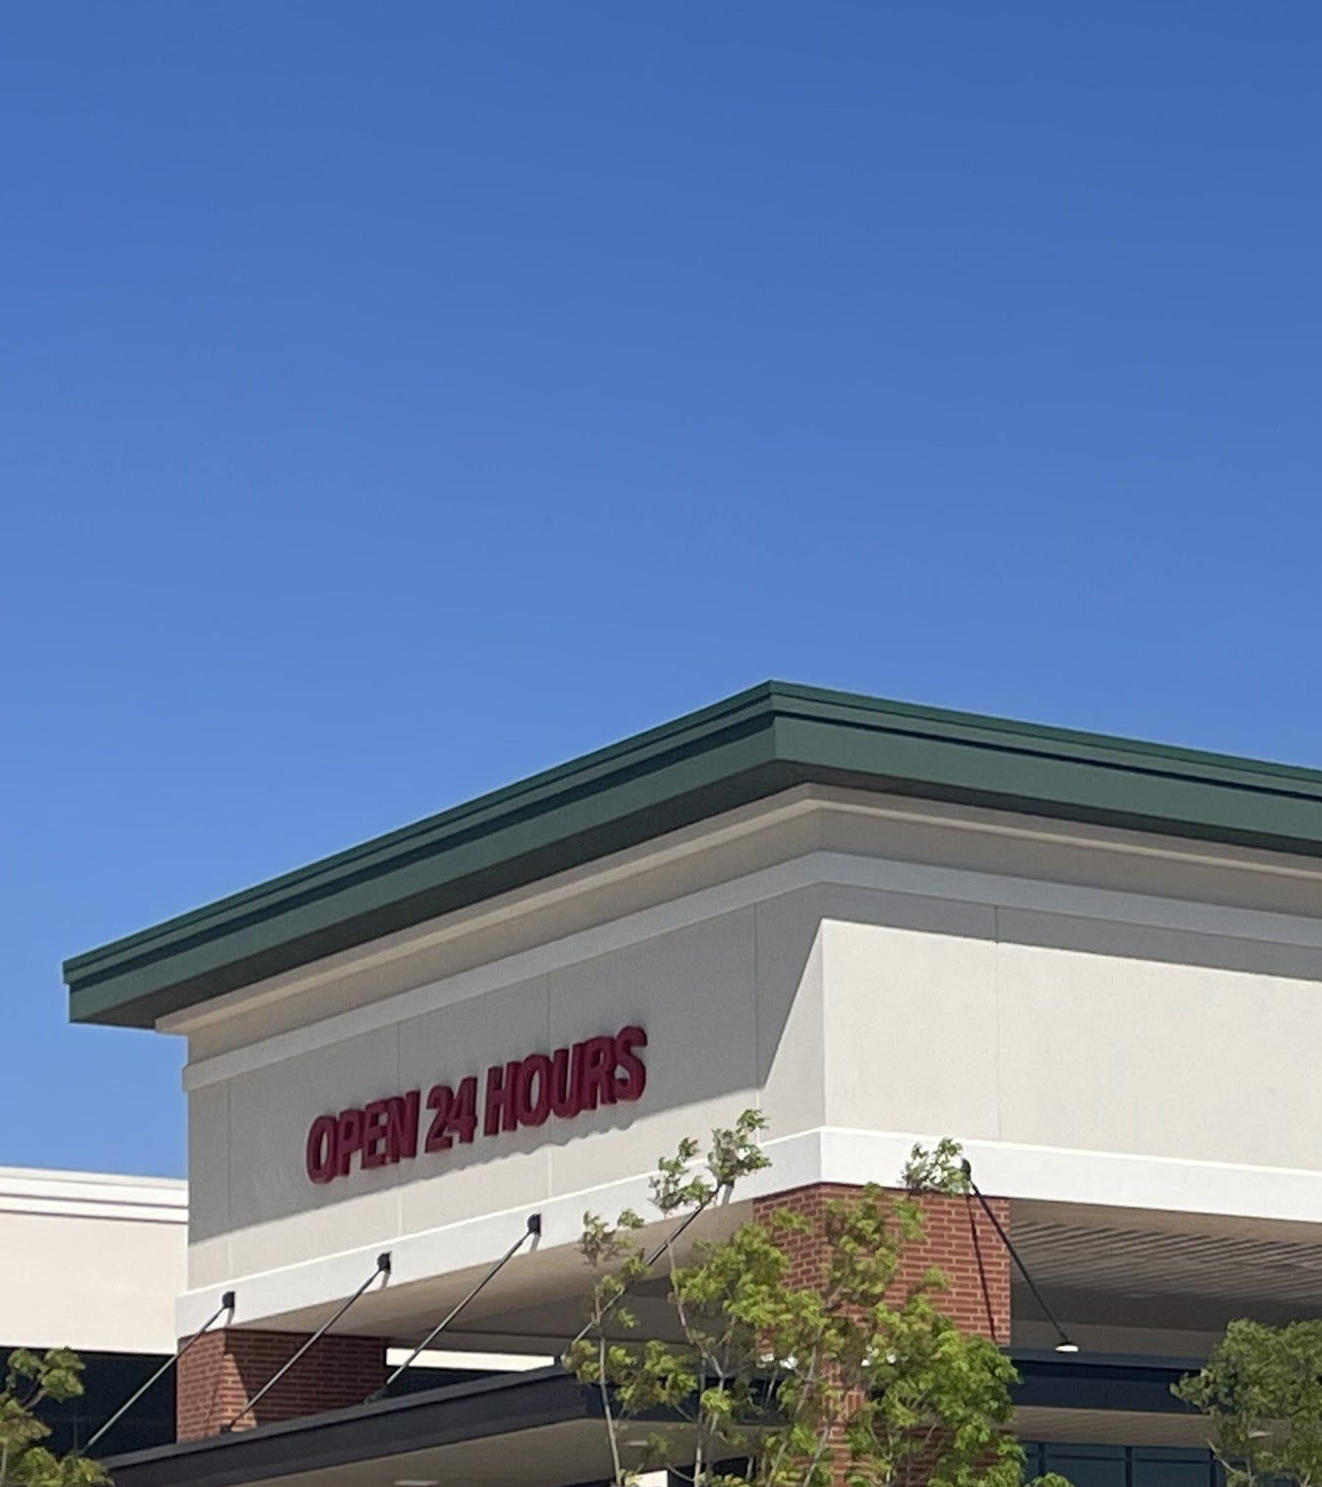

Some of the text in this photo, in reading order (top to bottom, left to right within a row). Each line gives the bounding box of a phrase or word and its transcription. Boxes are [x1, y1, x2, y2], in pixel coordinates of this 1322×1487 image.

[306, 1025, 648, 1183] OPEN 24 HOURS
